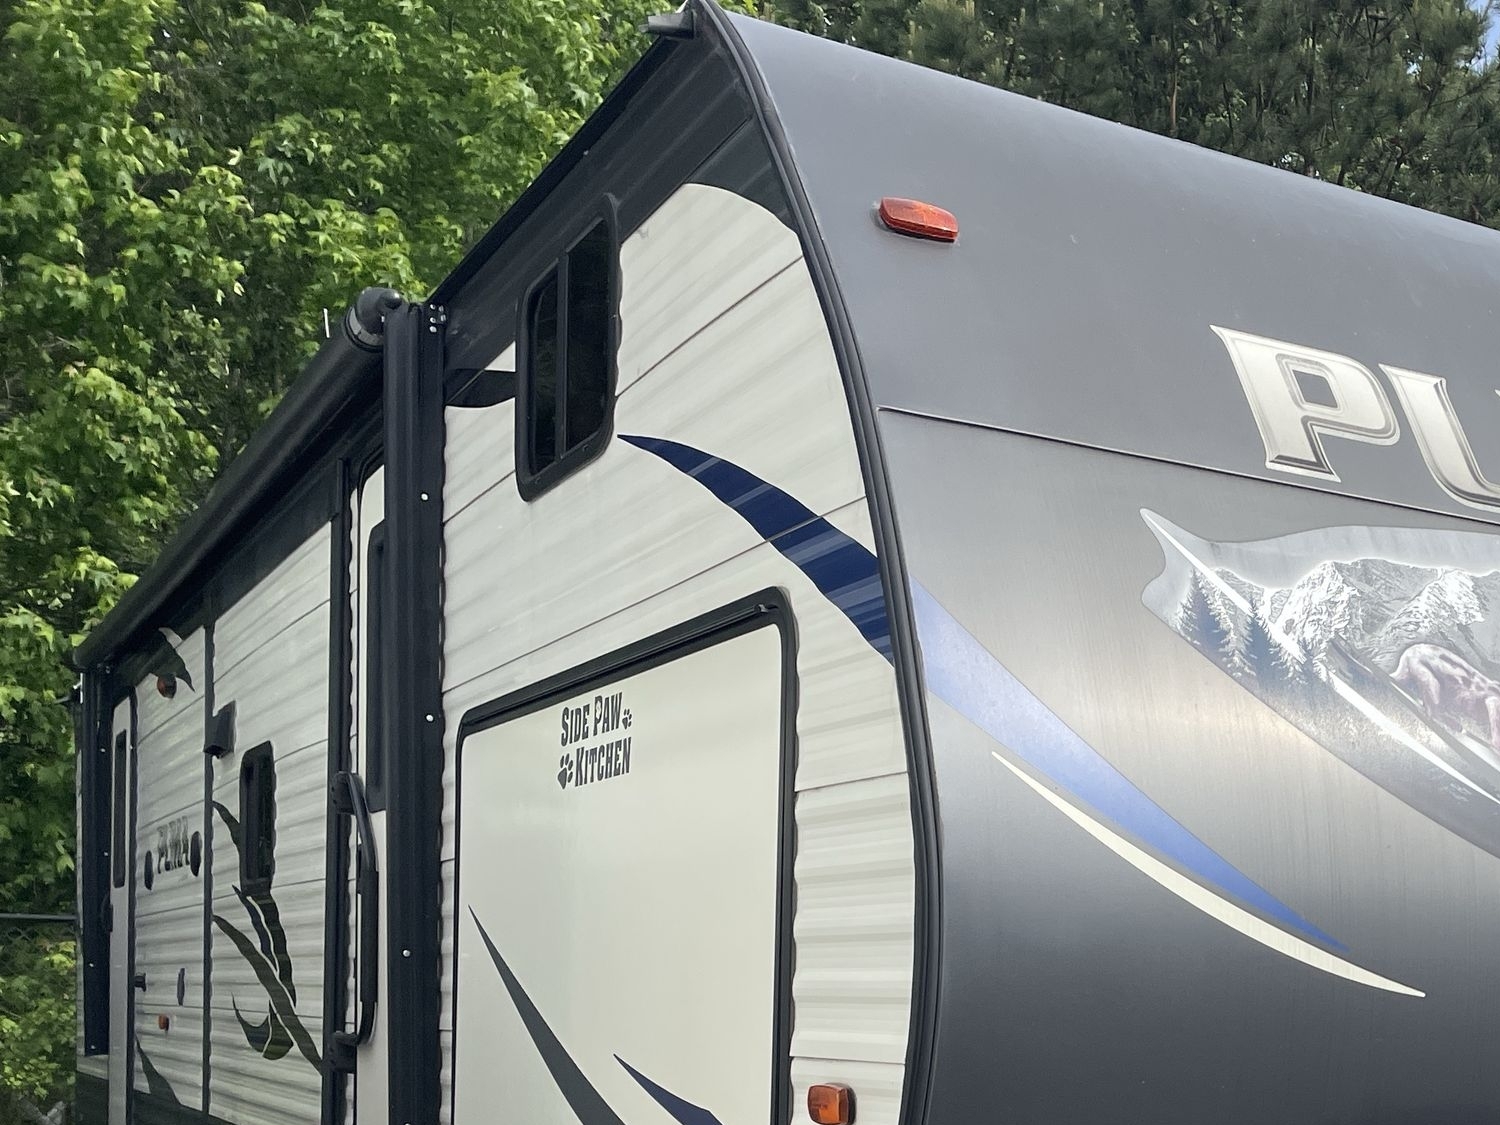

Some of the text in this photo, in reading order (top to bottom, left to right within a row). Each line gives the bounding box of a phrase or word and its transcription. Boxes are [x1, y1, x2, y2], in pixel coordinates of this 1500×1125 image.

[561, 691, 623, 747] SIDE PAW
[574, 736, 632, 788] KITCHEN
